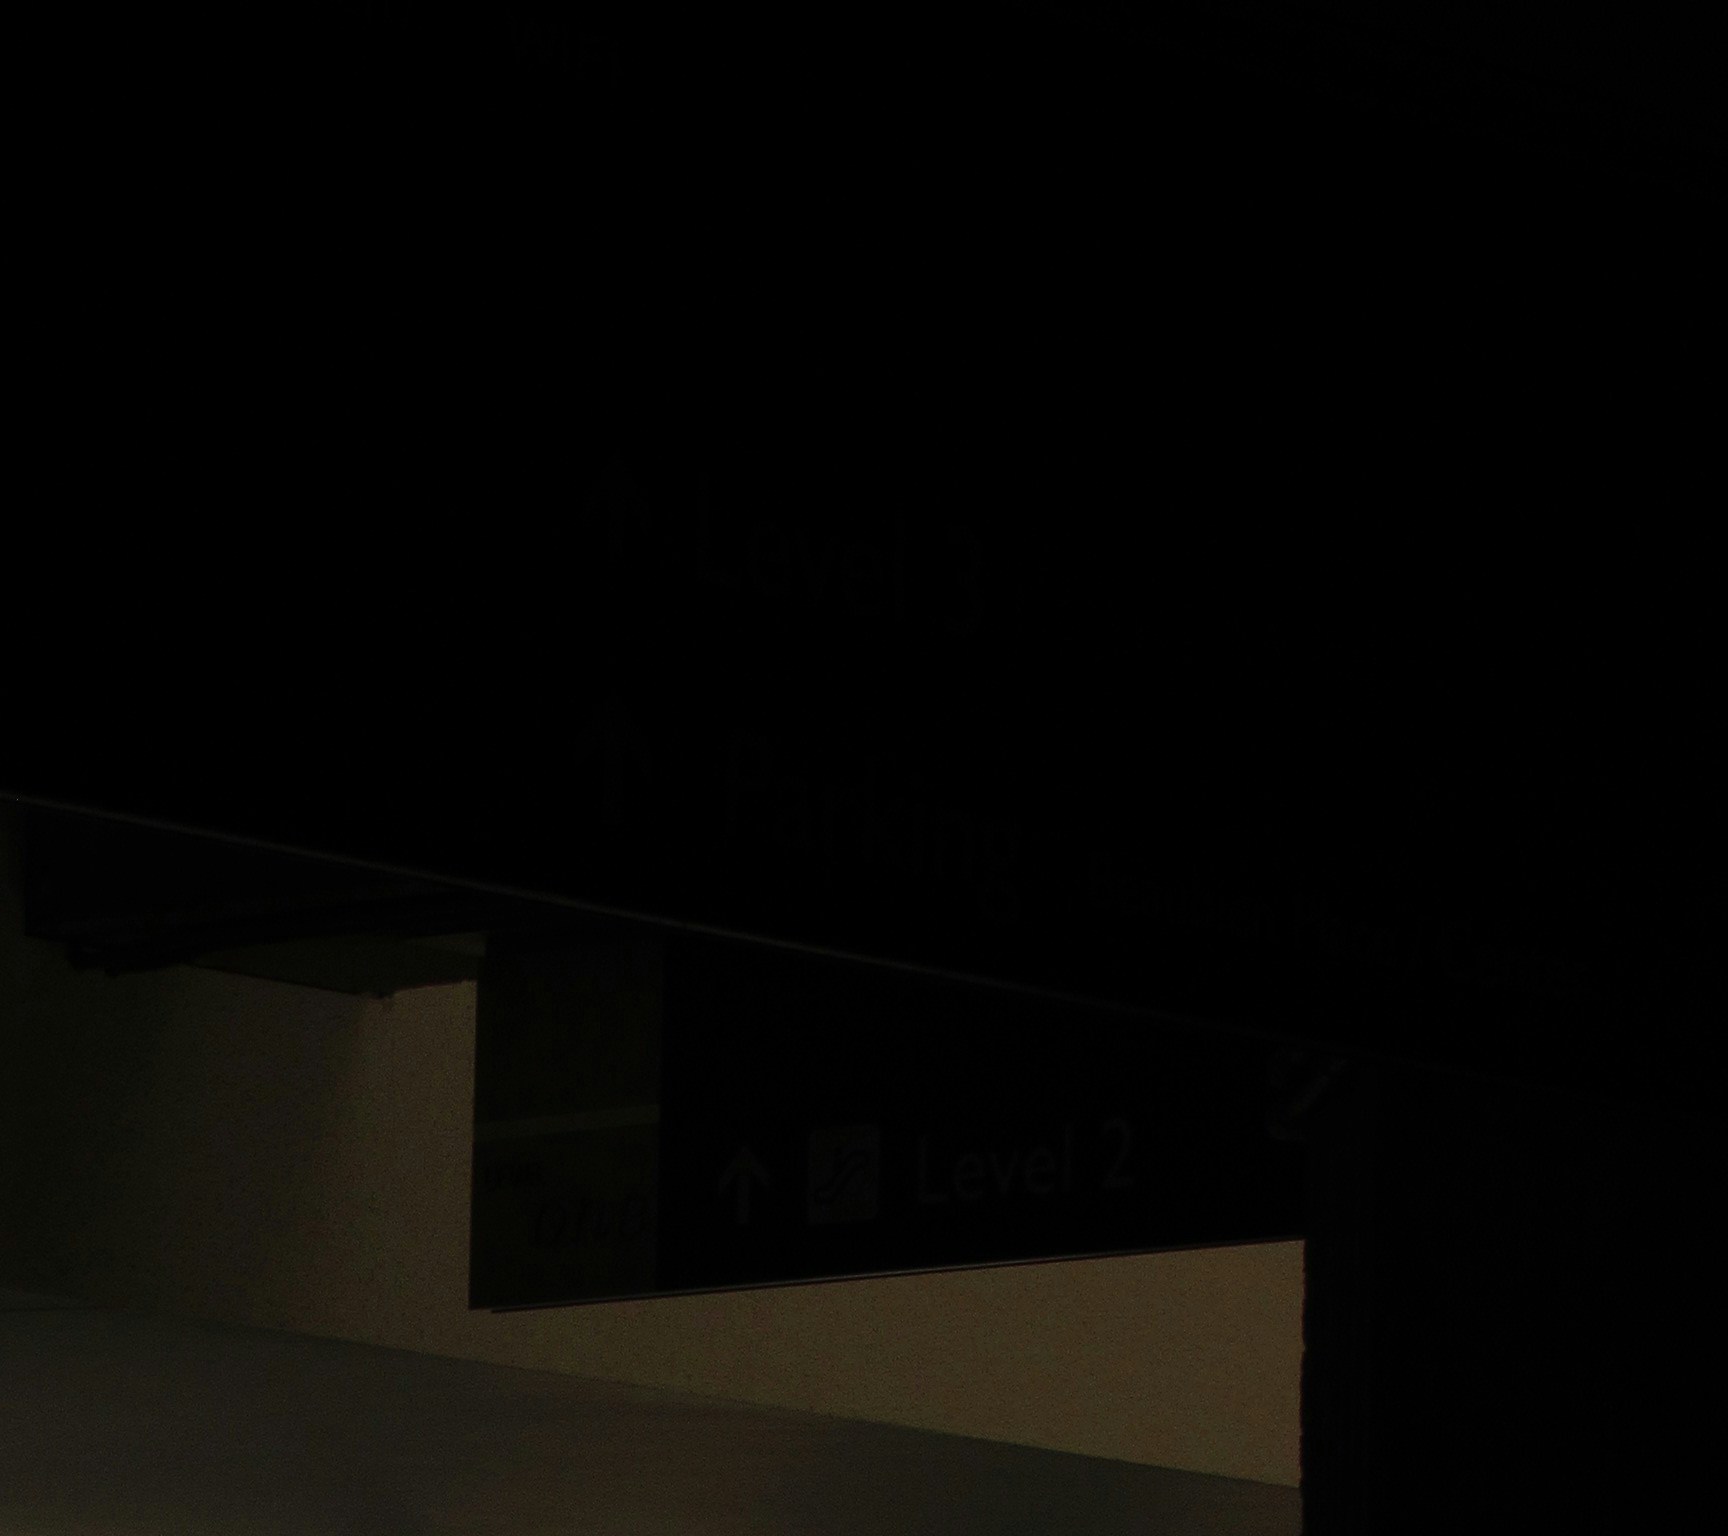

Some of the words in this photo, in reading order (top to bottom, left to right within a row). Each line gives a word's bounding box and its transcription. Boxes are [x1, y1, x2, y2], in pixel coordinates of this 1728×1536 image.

[695, 470, 905, 623] Level
[944, 522, 985, 638] 3
[723, 726, 1022, 925] Parking
[918, 1122, 1071, 1205] Level
[1100, 1117, 1136, 1190] 2
